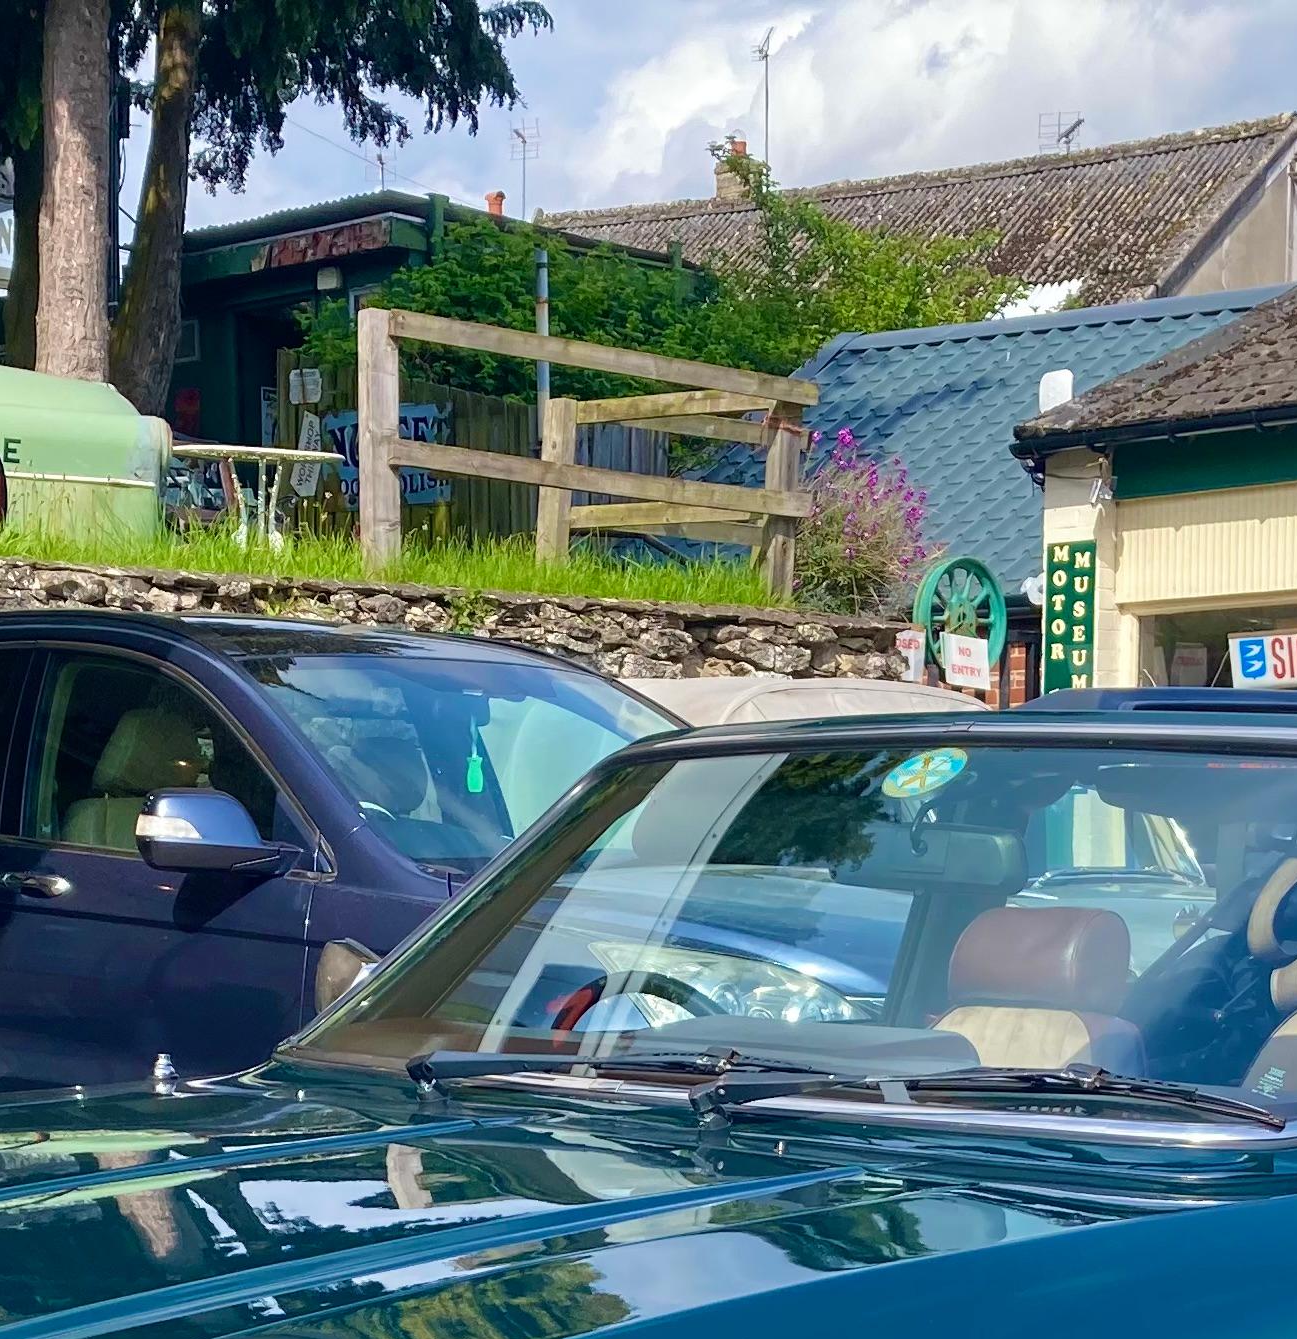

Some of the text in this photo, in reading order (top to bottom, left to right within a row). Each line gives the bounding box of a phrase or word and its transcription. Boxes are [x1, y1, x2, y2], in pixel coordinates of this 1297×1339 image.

[1050, 545, 1069, 660] MOTOR
[1072, 551, 1091, 688] MUSEUM
[951, 664, 982, 677] ENTRY
[958, 646, 972, 657] NO
